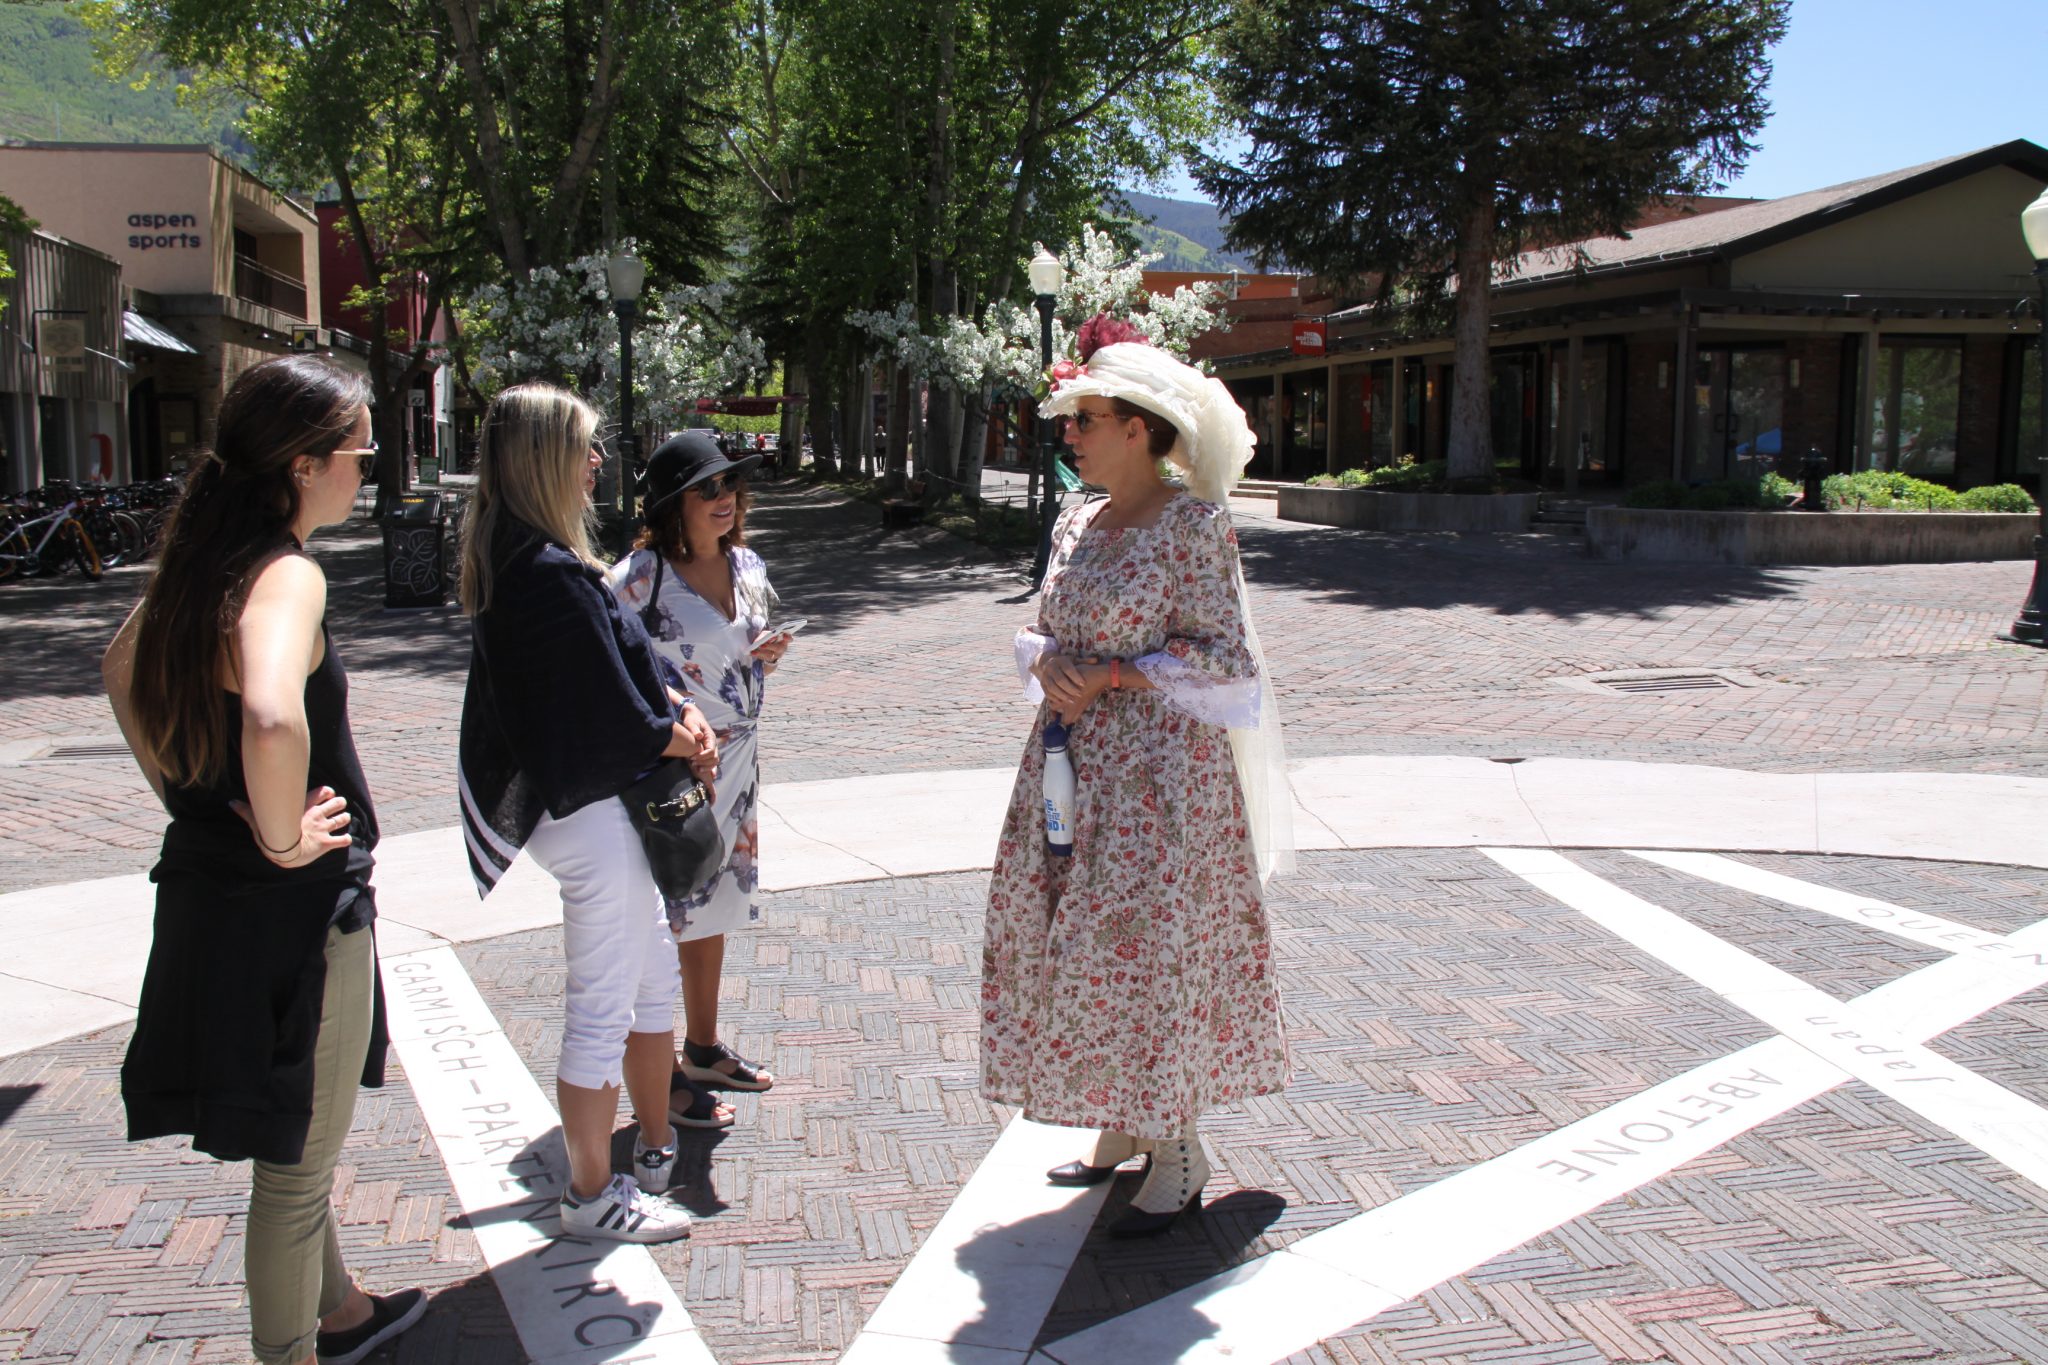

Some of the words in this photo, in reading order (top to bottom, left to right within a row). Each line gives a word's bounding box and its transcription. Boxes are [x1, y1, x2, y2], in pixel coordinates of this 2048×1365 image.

[127, 214, 196, 230] aspen
[128, 233, 201, 250] sports
[1804, 1015, 1956, 1083] Japan
[1536, 1067, 1783, 1183] ABETONE
